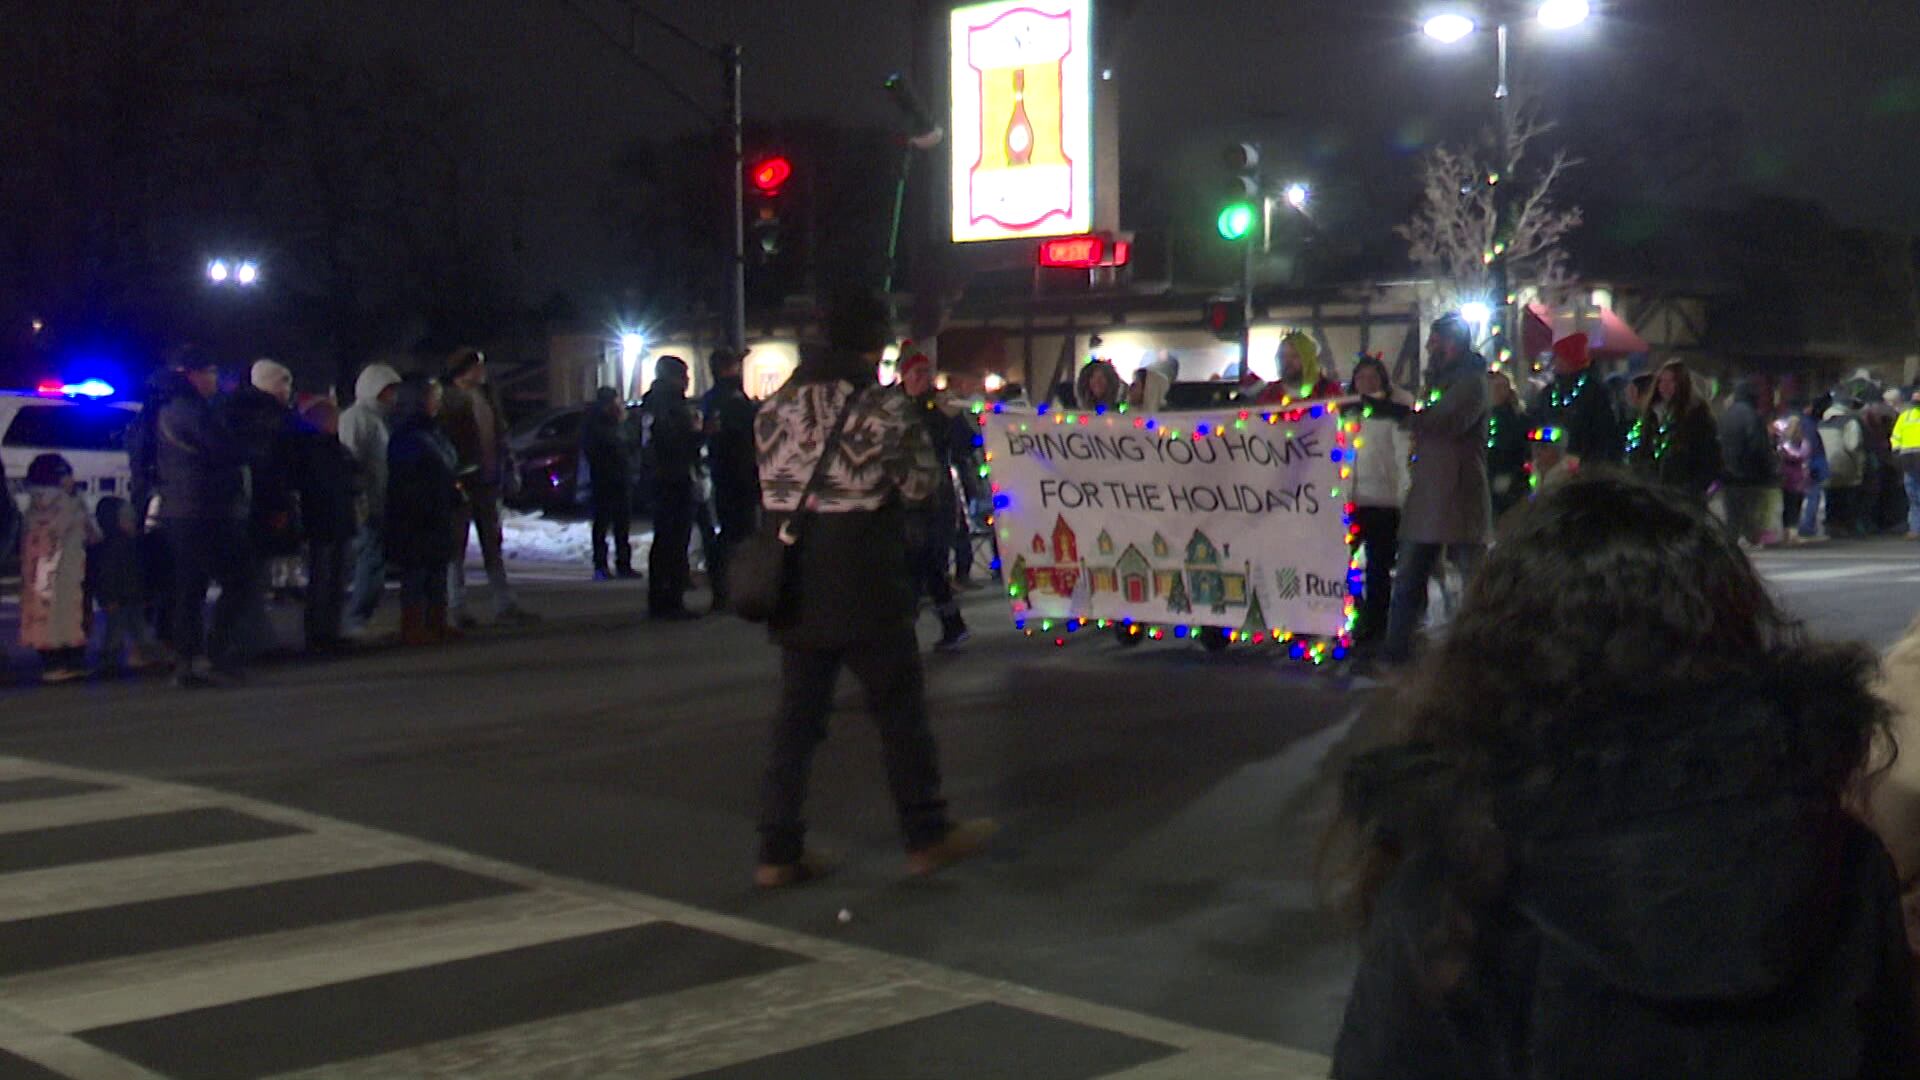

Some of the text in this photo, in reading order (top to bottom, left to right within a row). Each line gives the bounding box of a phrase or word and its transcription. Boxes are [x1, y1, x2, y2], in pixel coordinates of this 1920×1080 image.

[1007, 431, 1325, 467] BRINGING YOU HOME
[1039, 480, 1319, 514] FOR THE HOLIDAYS
